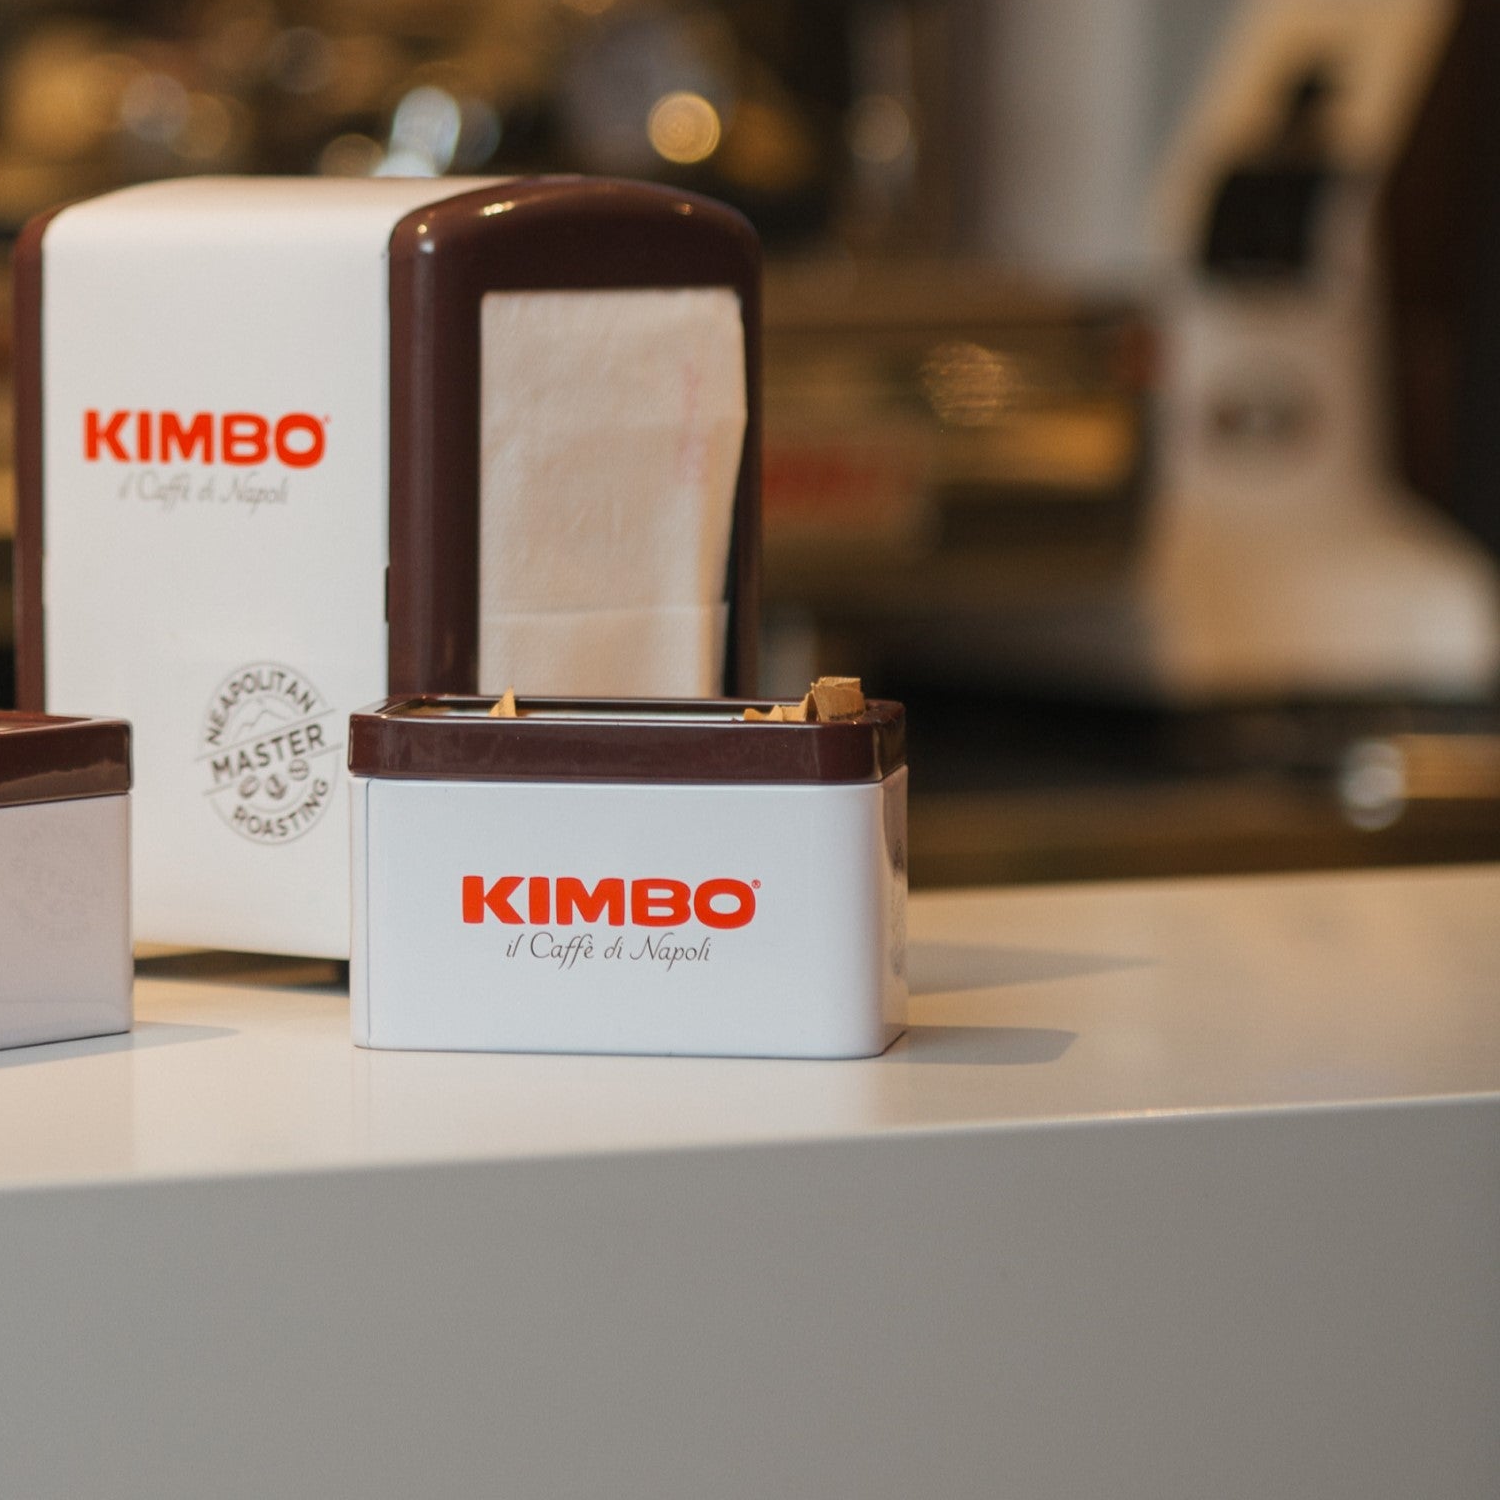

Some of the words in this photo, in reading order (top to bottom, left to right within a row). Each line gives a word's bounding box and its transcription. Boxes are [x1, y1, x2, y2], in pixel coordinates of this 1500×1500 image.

[84, 410, 326, 471] KIMBO
[206, 671, 316, 746] NEAPOLITAN
[211, 723, 325, 784] MASTER
[233, 778, 329, 837] ROASTING
[462, 875, 756, 930] KIMBO
[505, 933, 525, 958] il
[530, 931, 595, 971] Caffè
[603, 936, 624, 959] di
[630, 932, 712, 972] Napoli
